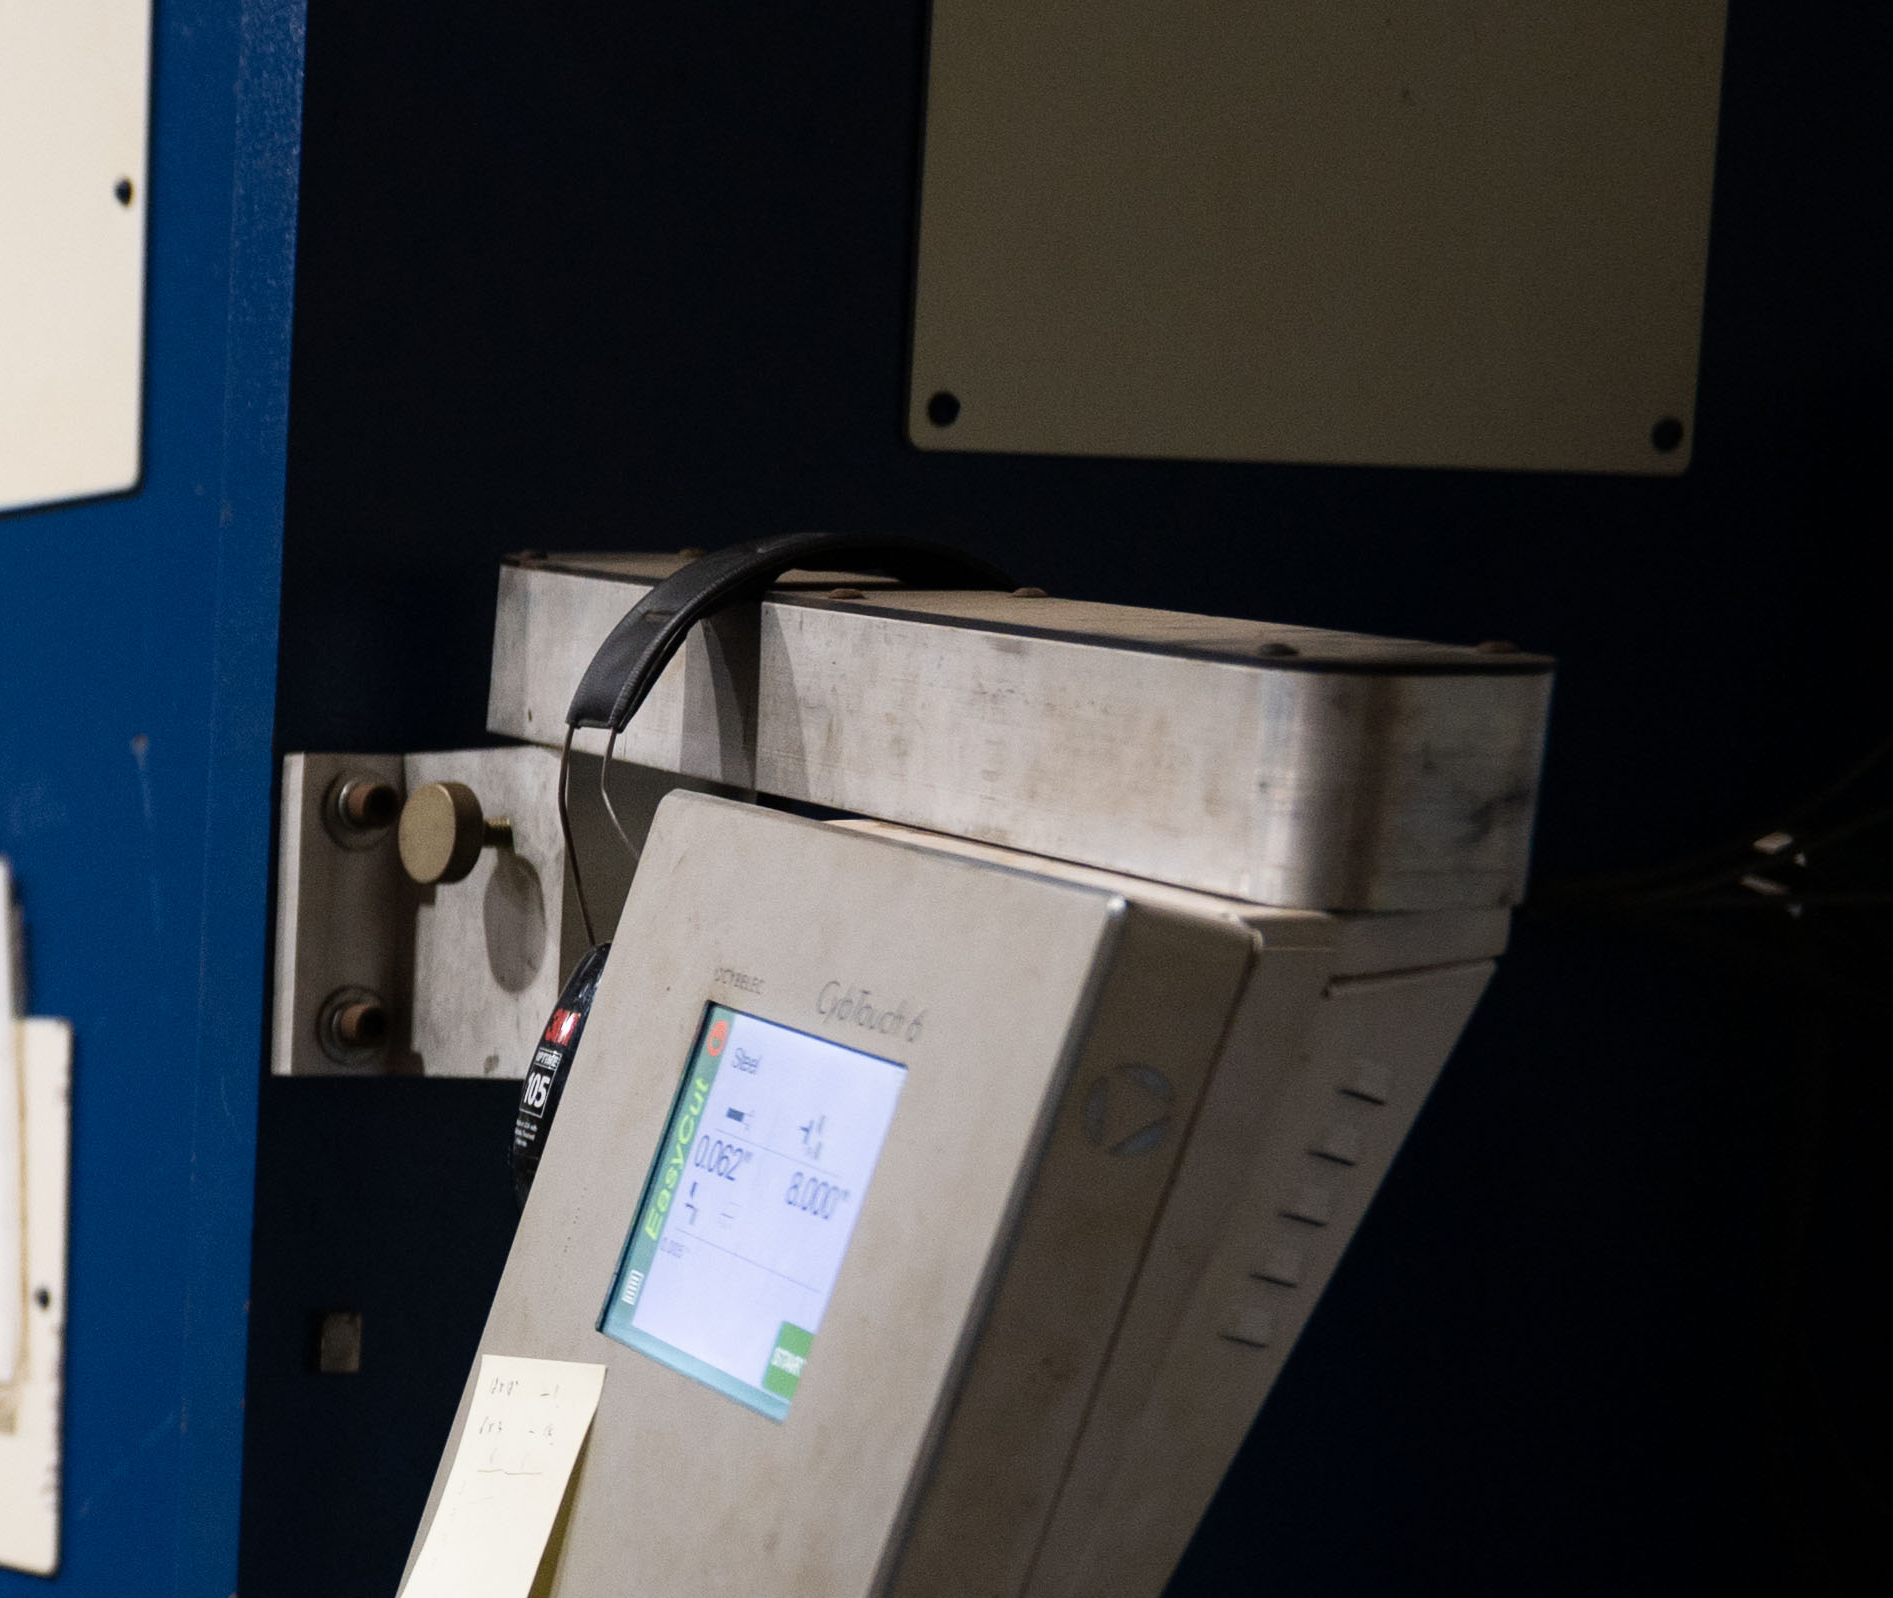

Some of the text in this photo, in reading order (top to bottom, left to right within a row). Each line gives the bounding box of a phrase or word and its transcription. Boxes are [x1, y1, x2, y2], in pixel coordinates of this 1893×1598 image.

[816, 980, 908, 1034] CybTouch
[544, 1008, 580, 1046] 3M
[731, 1046, 762, 1075] Steel
[523, 1072, 550, 1108] 105
[644, 1078, 709, 1241] EasyCut
